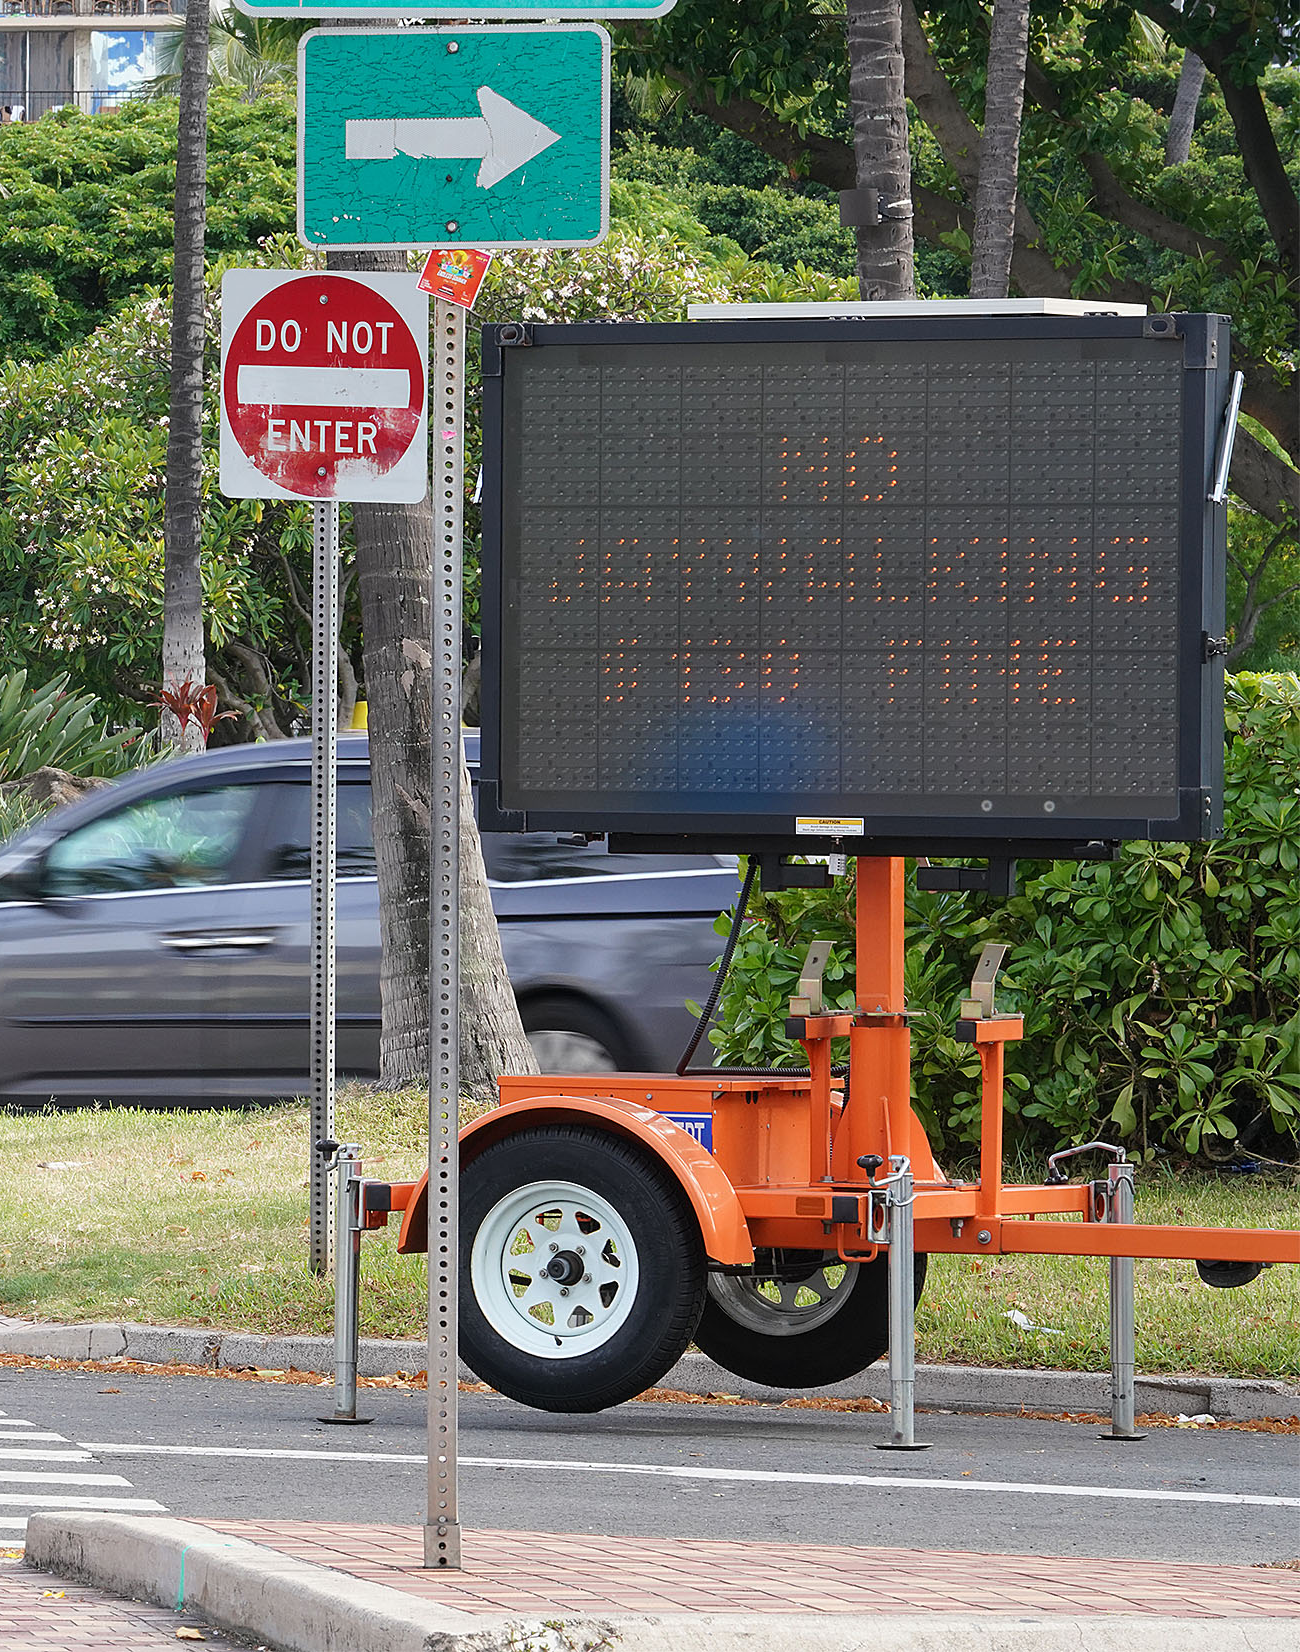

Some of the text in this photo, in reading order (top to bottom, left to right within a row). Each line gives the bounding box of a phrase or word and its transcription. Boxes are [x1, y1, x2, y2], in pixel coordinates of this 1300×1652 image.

[256, 319, 394, 354] DO NOT
[267, 419, 378, 454] ENTER
[779, 436, 898, 502] NO
[548, 537, 1149, 603] JAYWALKING
[885, 639, 1076, 704] FINE
